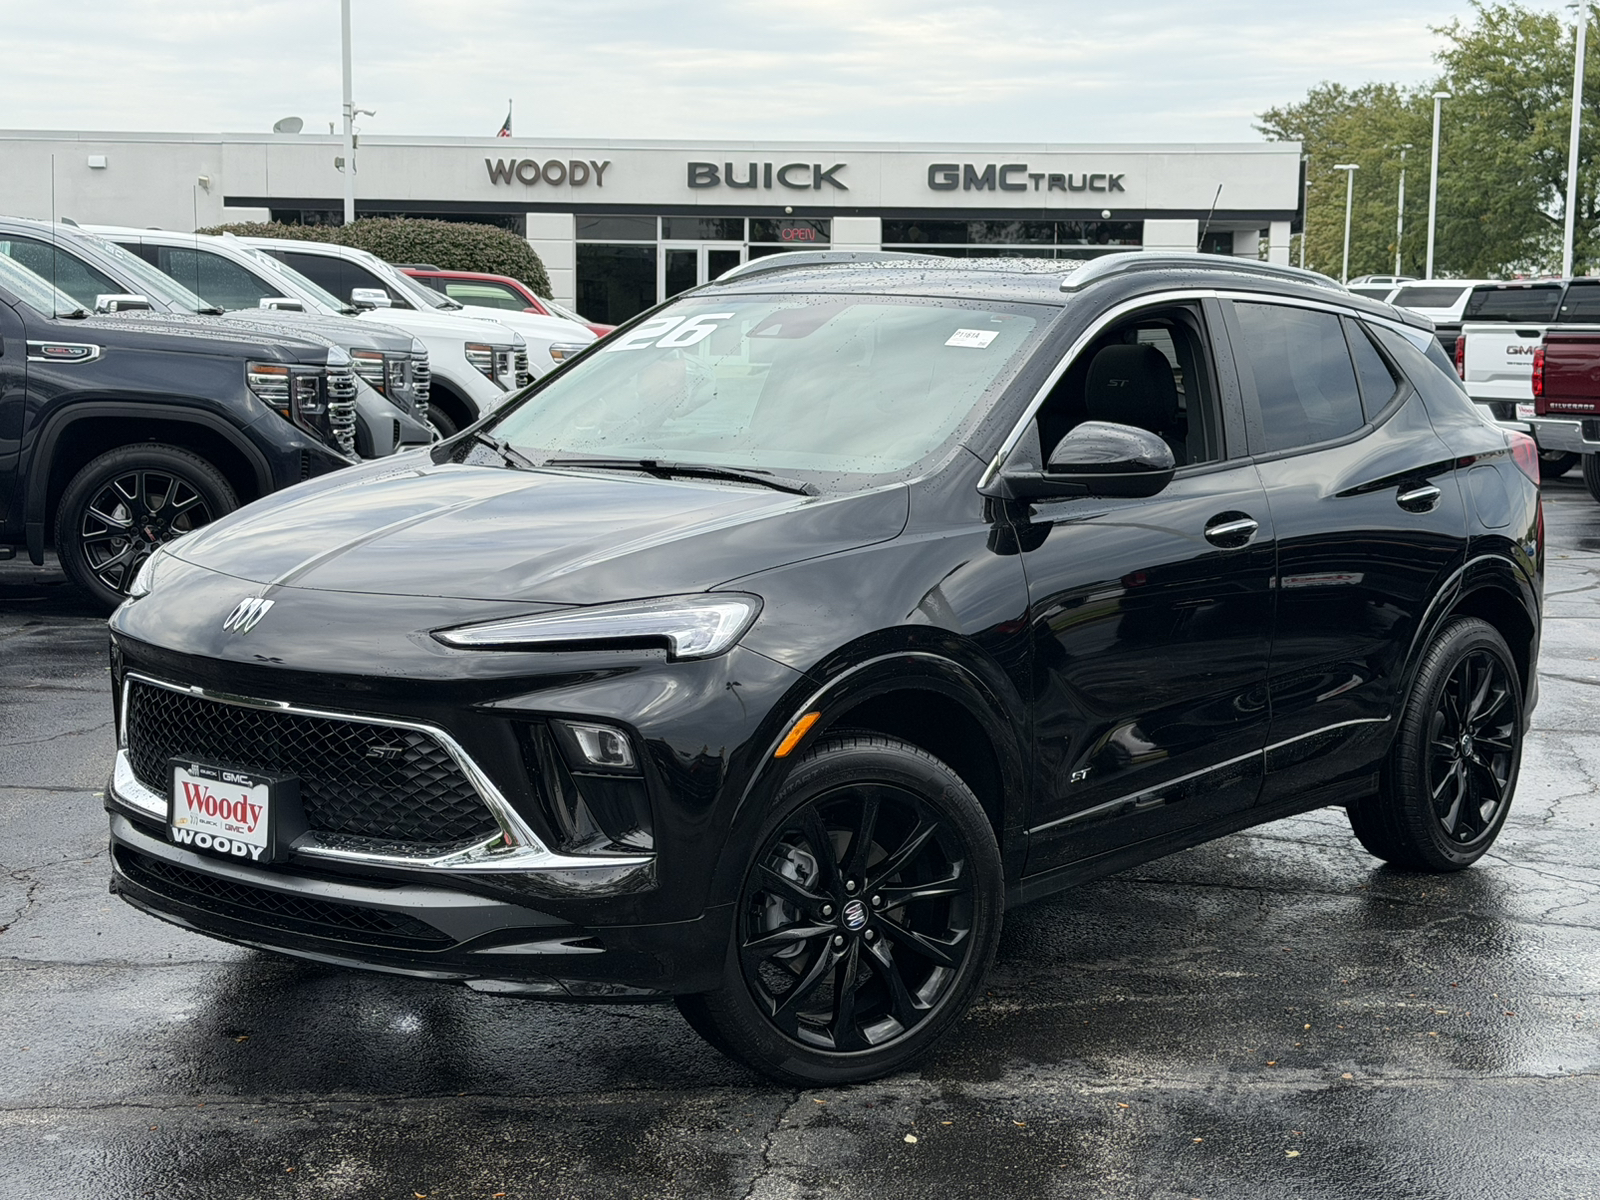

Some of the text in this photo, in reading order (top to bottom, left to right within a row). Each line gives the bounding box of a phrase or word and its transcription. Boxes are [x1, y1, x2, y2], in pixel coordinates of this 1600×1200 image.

[484, 158, 612, 187] WOODY
[687, 162, 849, 190] BUICK
[928, 163, 1125, 192] GMC TRUCK
[782, 228, 815, 240] OPEN
[606, 312, 736, 353] 26
[1107, 379, 1129, 387] ST
[1549, 402, 1595, 410] SILVERADO
[365, 746, 402, 759] ST
[200, 769, 248, 785] BUICK GMC
[1070, 767, 1092, 783] ST
[181, 781, 263, 833] Woody
[199, 818, 245, 834] BUICK GMC
[171, 827, 265, 861] WOODY
